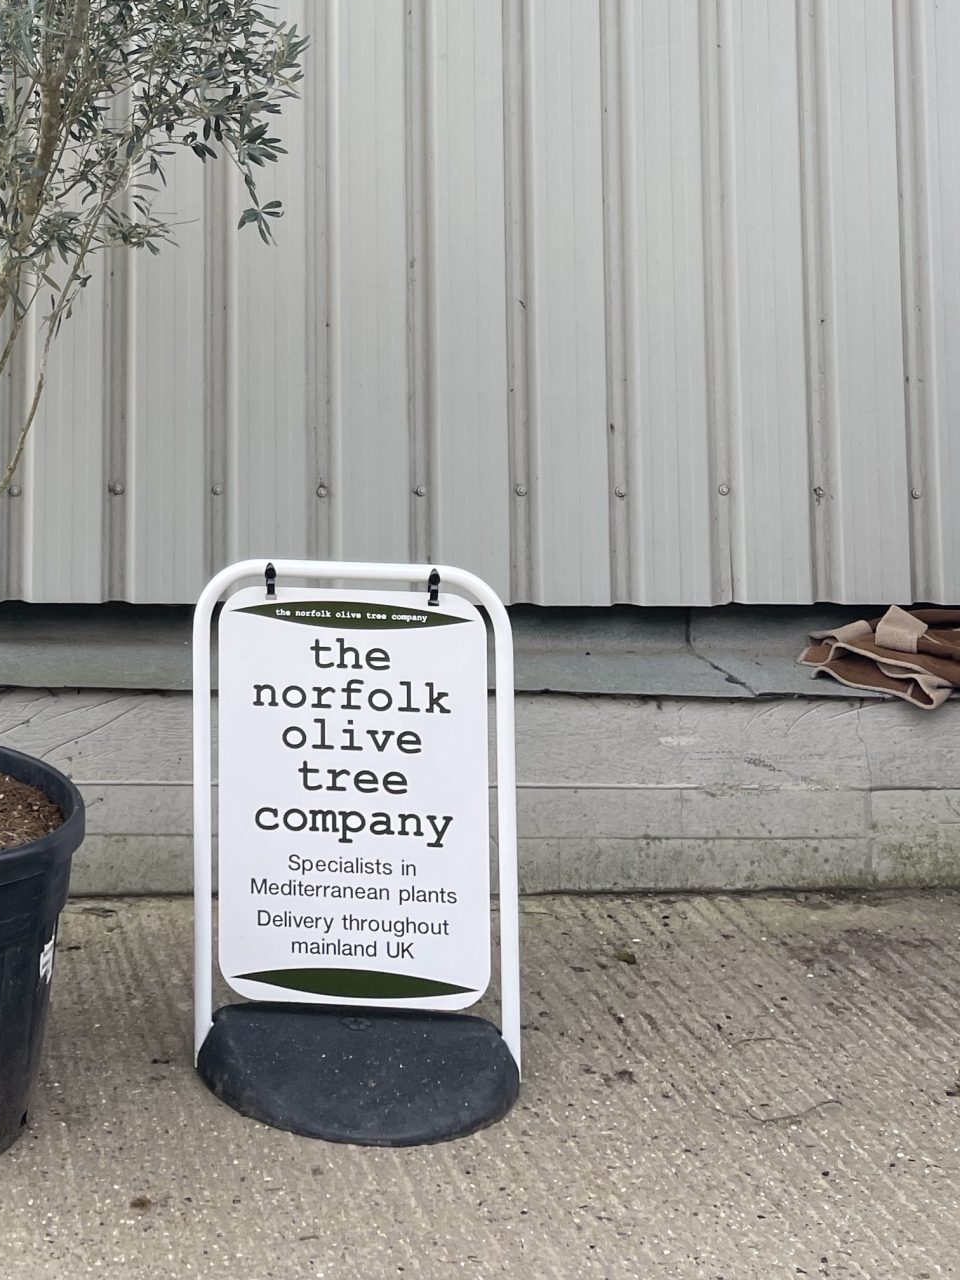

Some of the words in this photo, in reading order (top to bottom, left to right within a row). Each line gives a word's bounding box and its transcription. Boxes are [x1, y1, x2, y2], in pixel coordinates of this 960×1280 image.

[275, 608, 291, 616] the
[295, 608, 331, 618] norfolk
[335, 610, 361, 619] olive
[366, 611, 386, 620] tree
[390, 613, 427, 623] company
[309, 637, 391, 671] the
[252, 678, 452, 714] norfolk
[281, 718, 422, 754] olive
[297, 760, 408, 795] tree
[254, 806, 454, 848] company
[288, 854, 393, 876] Specialists
[401, 859, 417, 877] in
[250, 877, 390, 901] Mediterranean
[399, 885, 458, 906] plants
[257, 909, 334, 934] Delivery
[341, 913, 450, 938] throughout
[291, 937, 377, 958] mainland
[386, 941, 415, 960] UK
